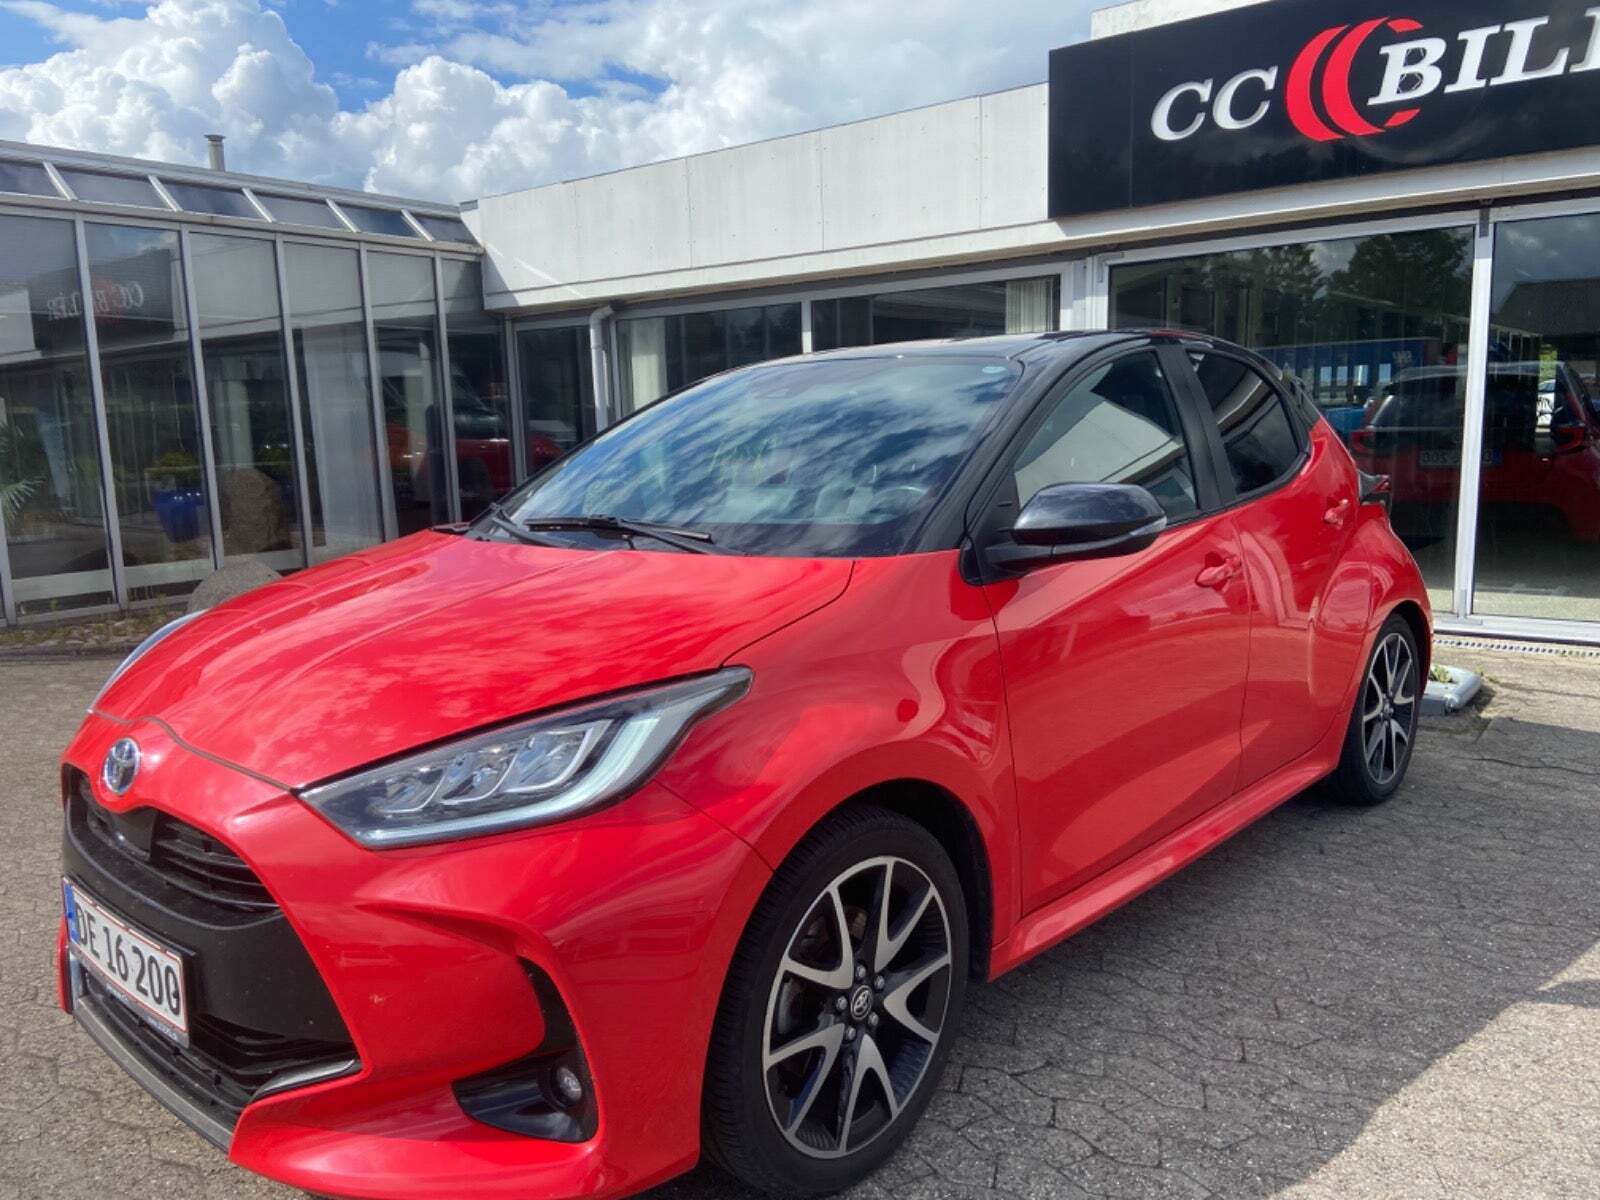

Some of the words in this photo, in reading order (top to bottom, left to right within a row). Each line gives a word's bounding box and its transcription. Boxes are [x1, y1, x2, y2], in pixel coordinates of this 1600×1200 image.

[1151, 66, 1278, 141] CC
[76, 904, 100, 958] DE
[103, 926, 129, 981] 16
[132, 946, 180, 1016] 200
